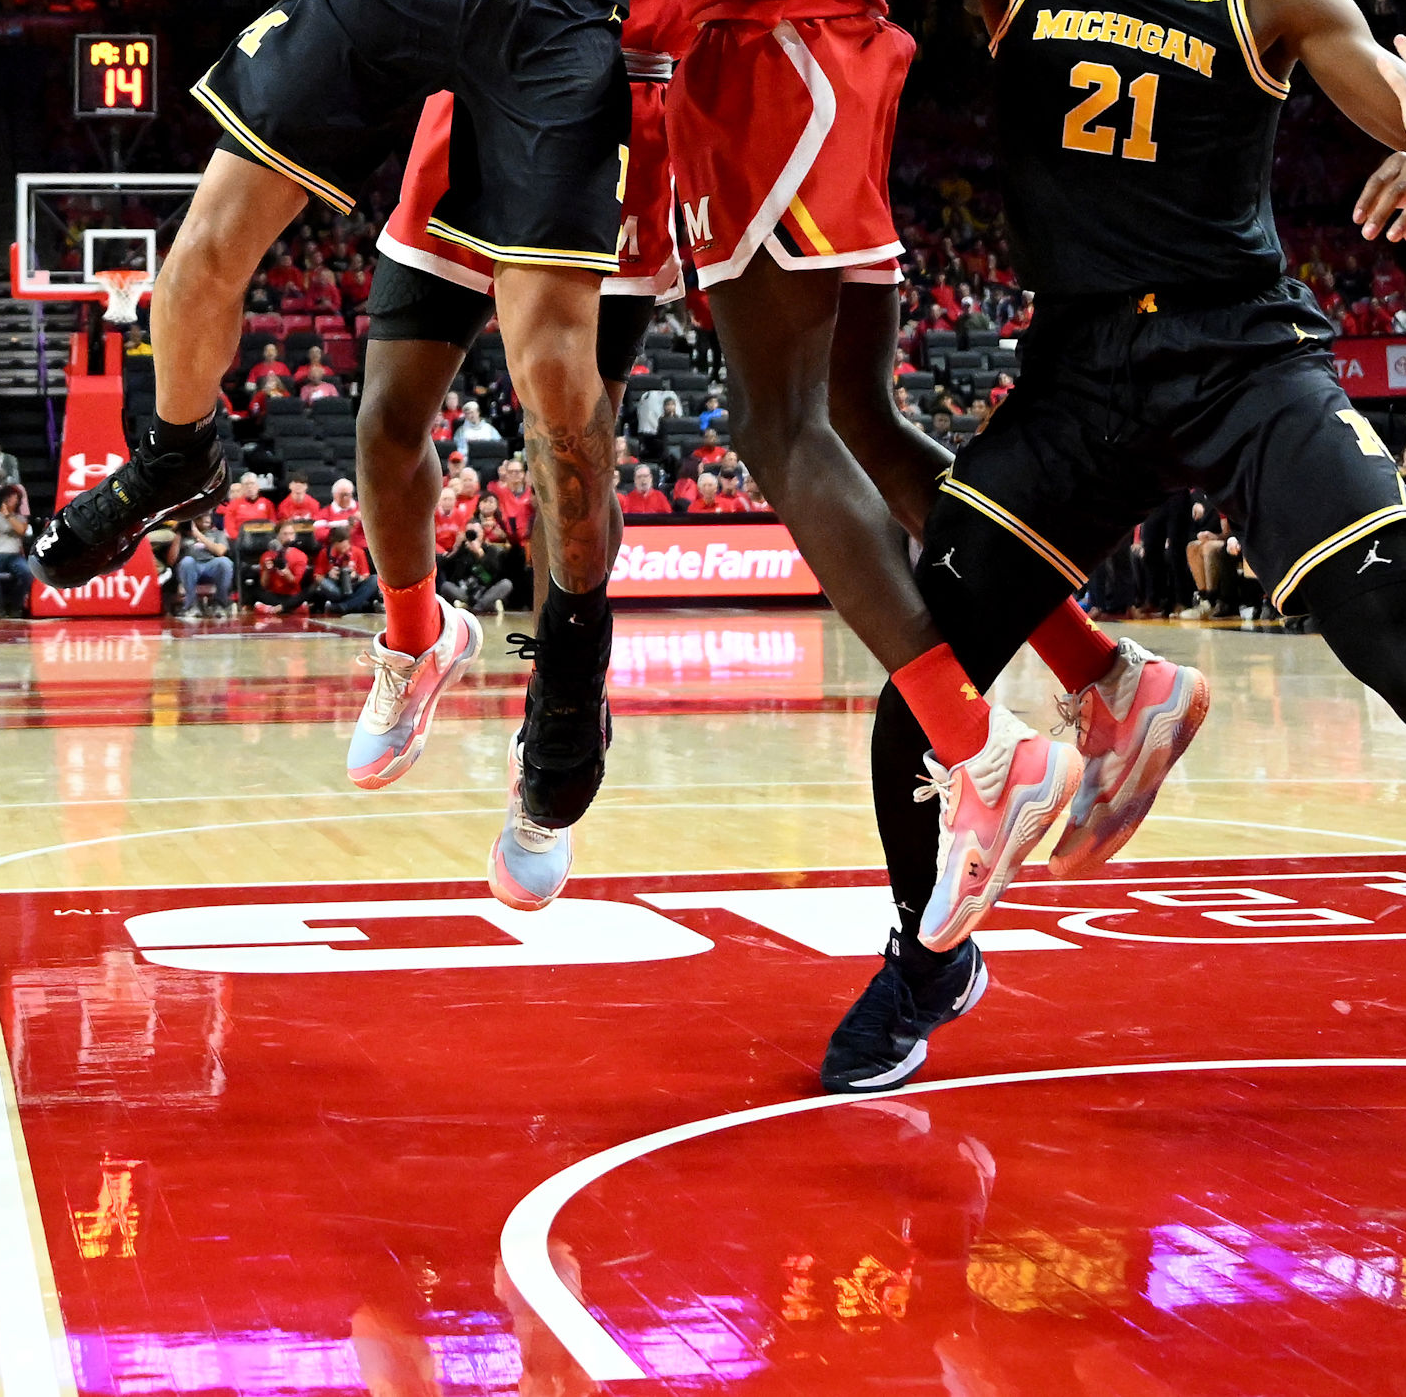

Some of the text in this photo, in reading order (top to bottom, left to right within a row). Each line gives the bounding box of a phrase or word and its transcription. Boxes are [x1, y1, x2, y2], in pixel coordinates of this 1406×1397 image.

[1033, 9, 1217, 78] MICHIGAN
[104, 67, 143, 108] 14
[1062, 61, 1160, 163] 21
[684, 196, 714, 252] M
